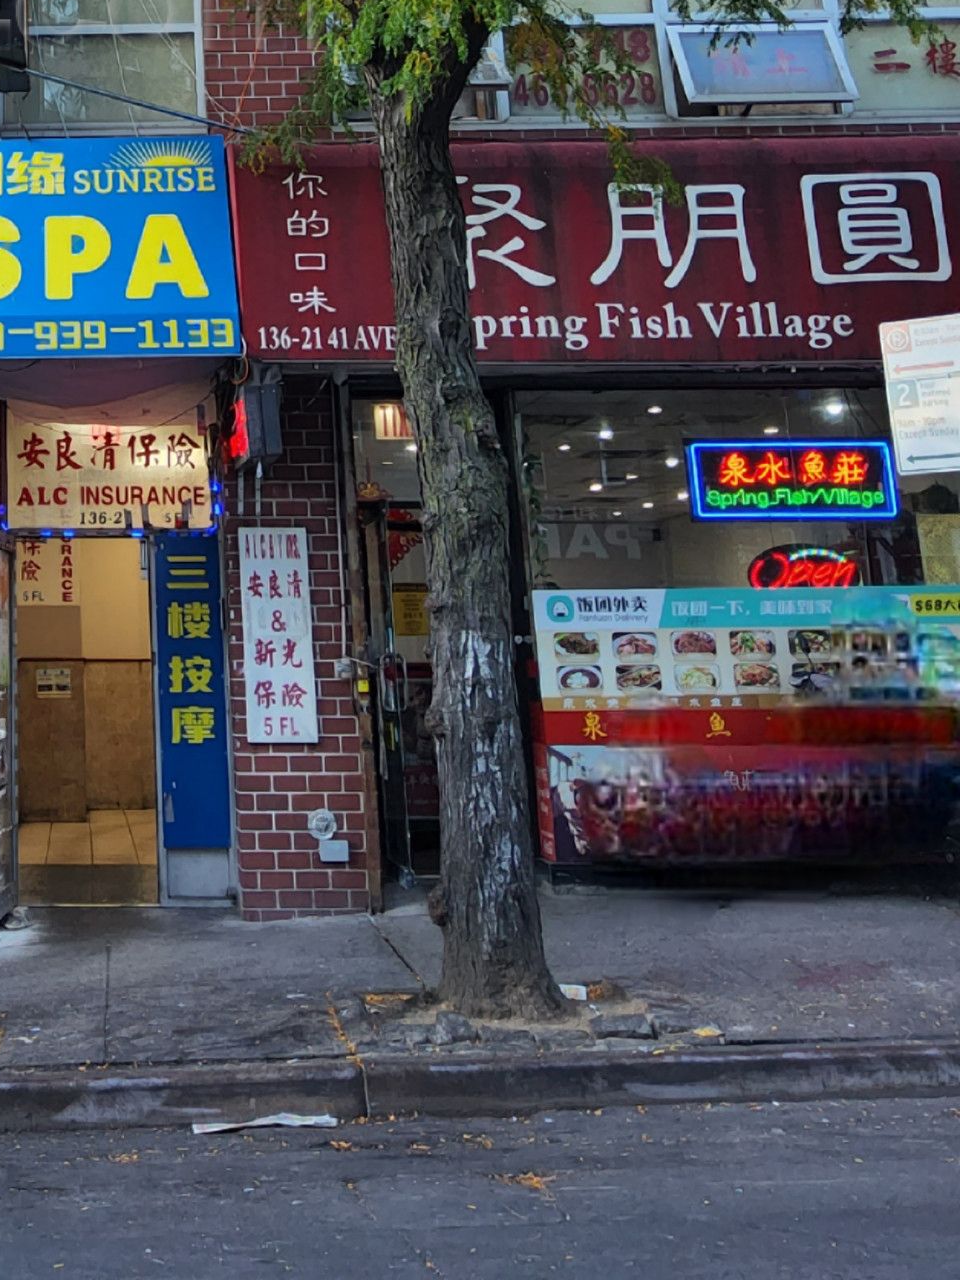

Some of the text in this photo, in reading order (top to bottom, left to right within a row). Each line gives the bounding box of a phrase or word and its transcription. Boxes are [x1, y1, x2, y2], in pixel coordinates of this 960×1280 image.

[74, 167, 216, 194] SUNRISE
[283, 172, 336, 315] 你的口味
[258, 326, 323, 351] 136-21
[328, 326, 349, 351] 41
[475, 302, 854, 350] pring Fish Village
[896, 383, 912, 408] 2
[17, 431, 200, 471] 安良清保險
[720, 450, 867, 486] 泉水魚莊
[17, 486, 205, 506] ALC INSURANCE
[706, 488, 770, 509] Spring
[248, 570, 303, 599] 安良清
[751, 551, 857, 589] Open
[577, 596, 647, 613] 饭团外卖
[271, 610, 287, 632] &
[166, 555, 216, 744] 三楼按摩
[254, 639, 303, 668] 新光
[254, 680, 307, 709] 保險
[264, 717, 273, 736] 5
